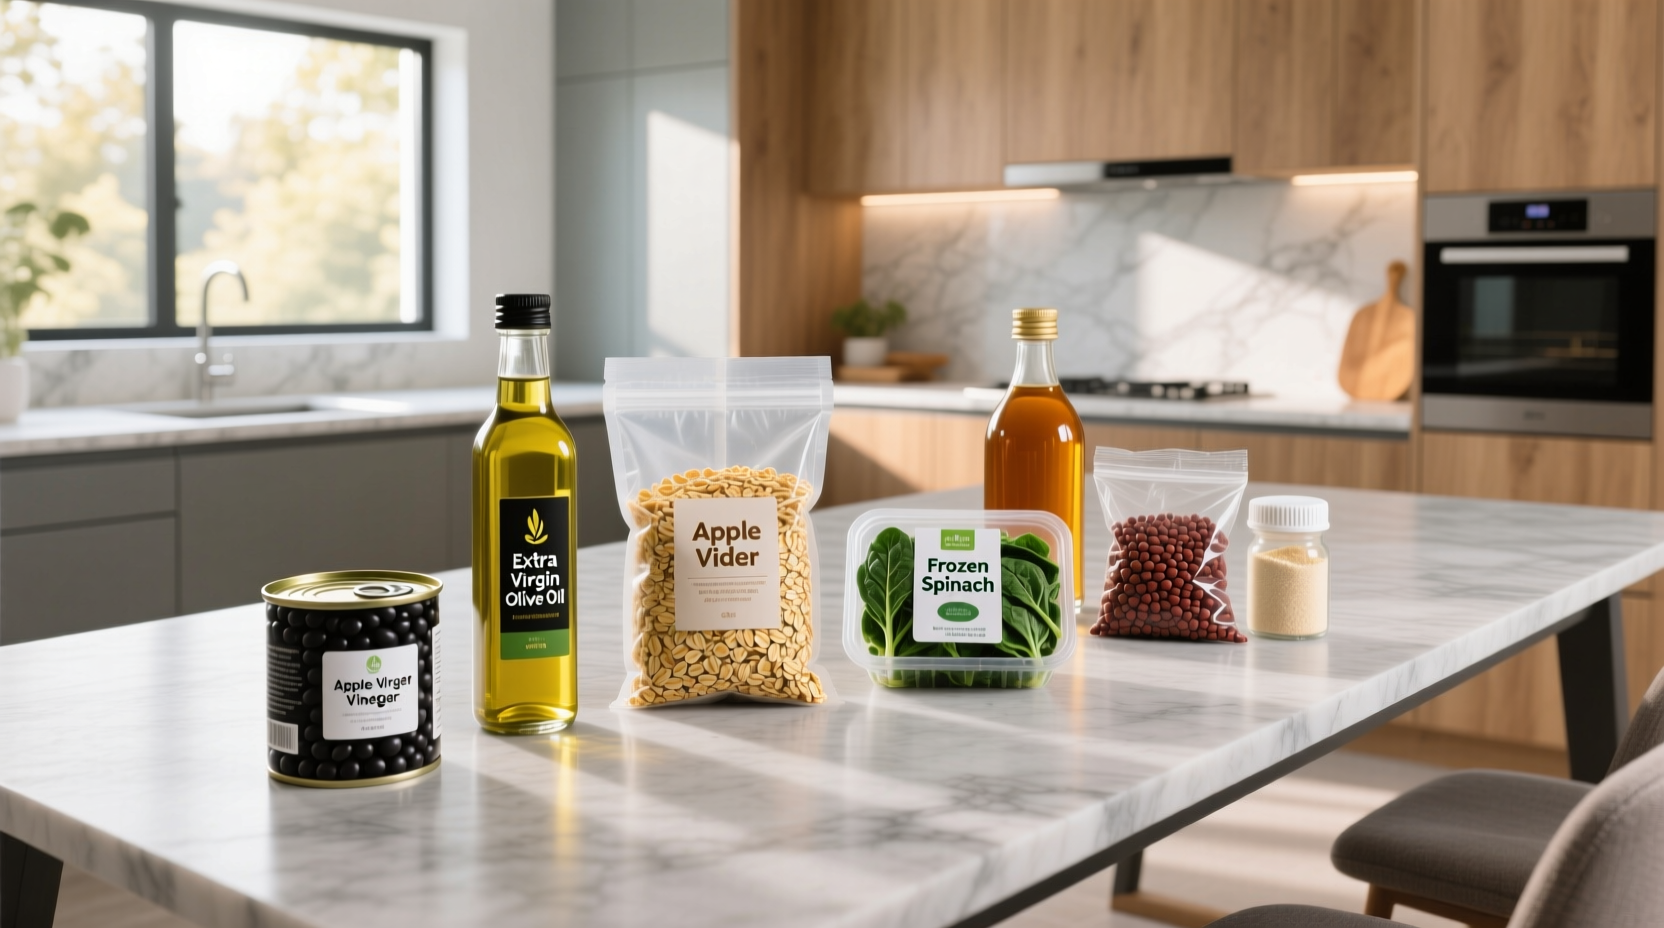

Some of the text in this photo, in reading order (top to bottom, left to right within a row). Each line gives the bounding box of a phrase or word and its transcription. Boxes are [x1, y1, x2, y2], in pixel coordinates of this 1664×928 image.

[692, 520, 761, 547] Apple
[512, 552, 558, 569] Extra
[695, 546, 760, 568] Vider
[928, 558, 989, 573] Frozen
[510, 571, 560, 591] Virgin
[921, 575, 995, 596] Spinach
[505, 590, 544, 607] Olive
[334, 679, 373, 694] Apple
